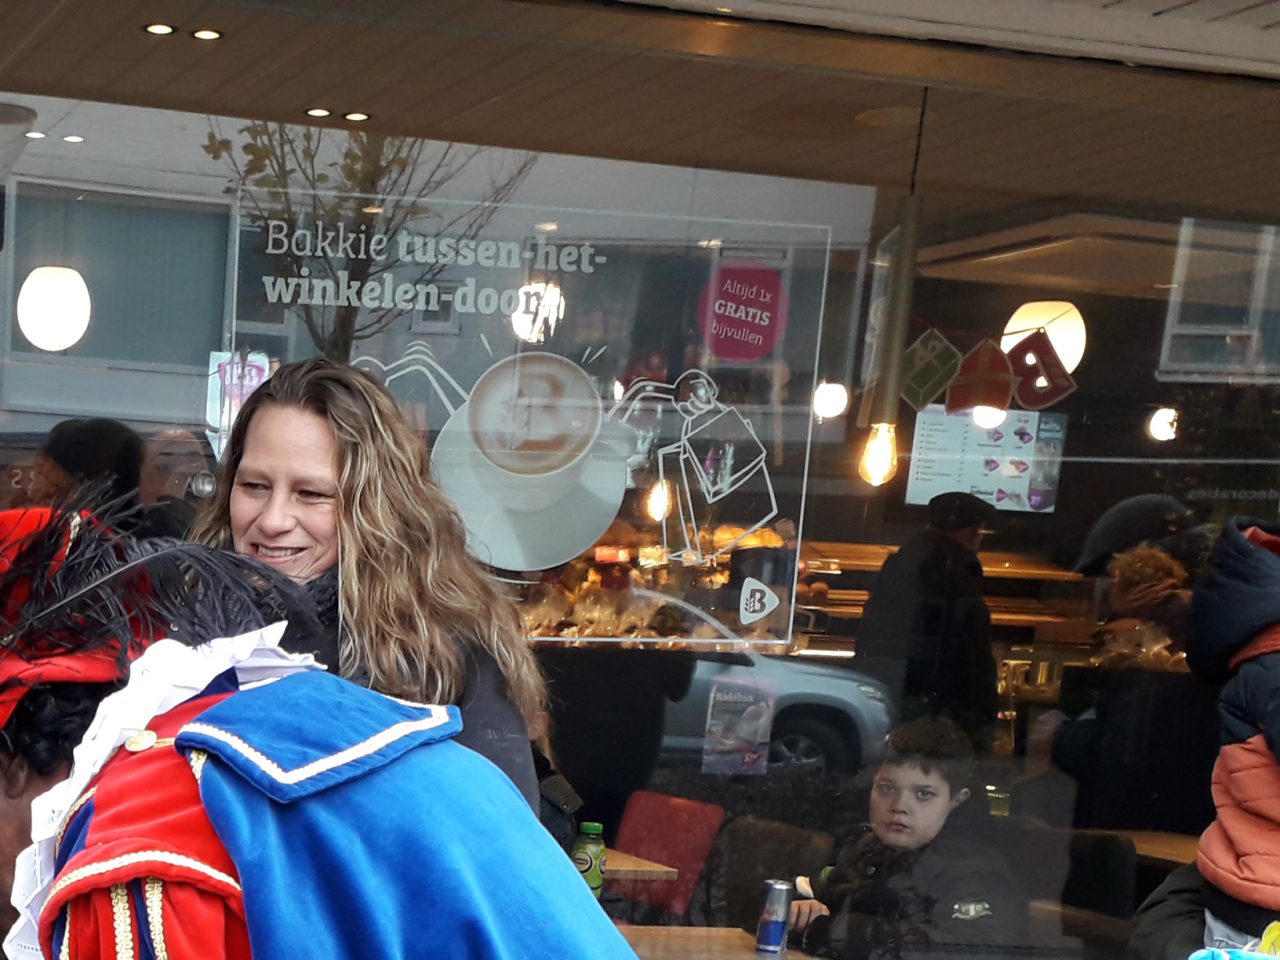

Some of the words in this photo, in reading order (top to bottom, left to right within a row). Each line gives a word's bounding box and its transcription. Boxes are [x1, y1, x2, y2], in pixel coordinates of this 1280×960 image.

[265, 219, 388, 261] Bakkie
[396, 228, 607, 274] tussen-het-
[722, 280, 758, 300] Altijd
[760, 289, 773, 302] 1x
[714, 299, 771, 326] GRATIS
[711, 319, 764, 346] bijvullen
